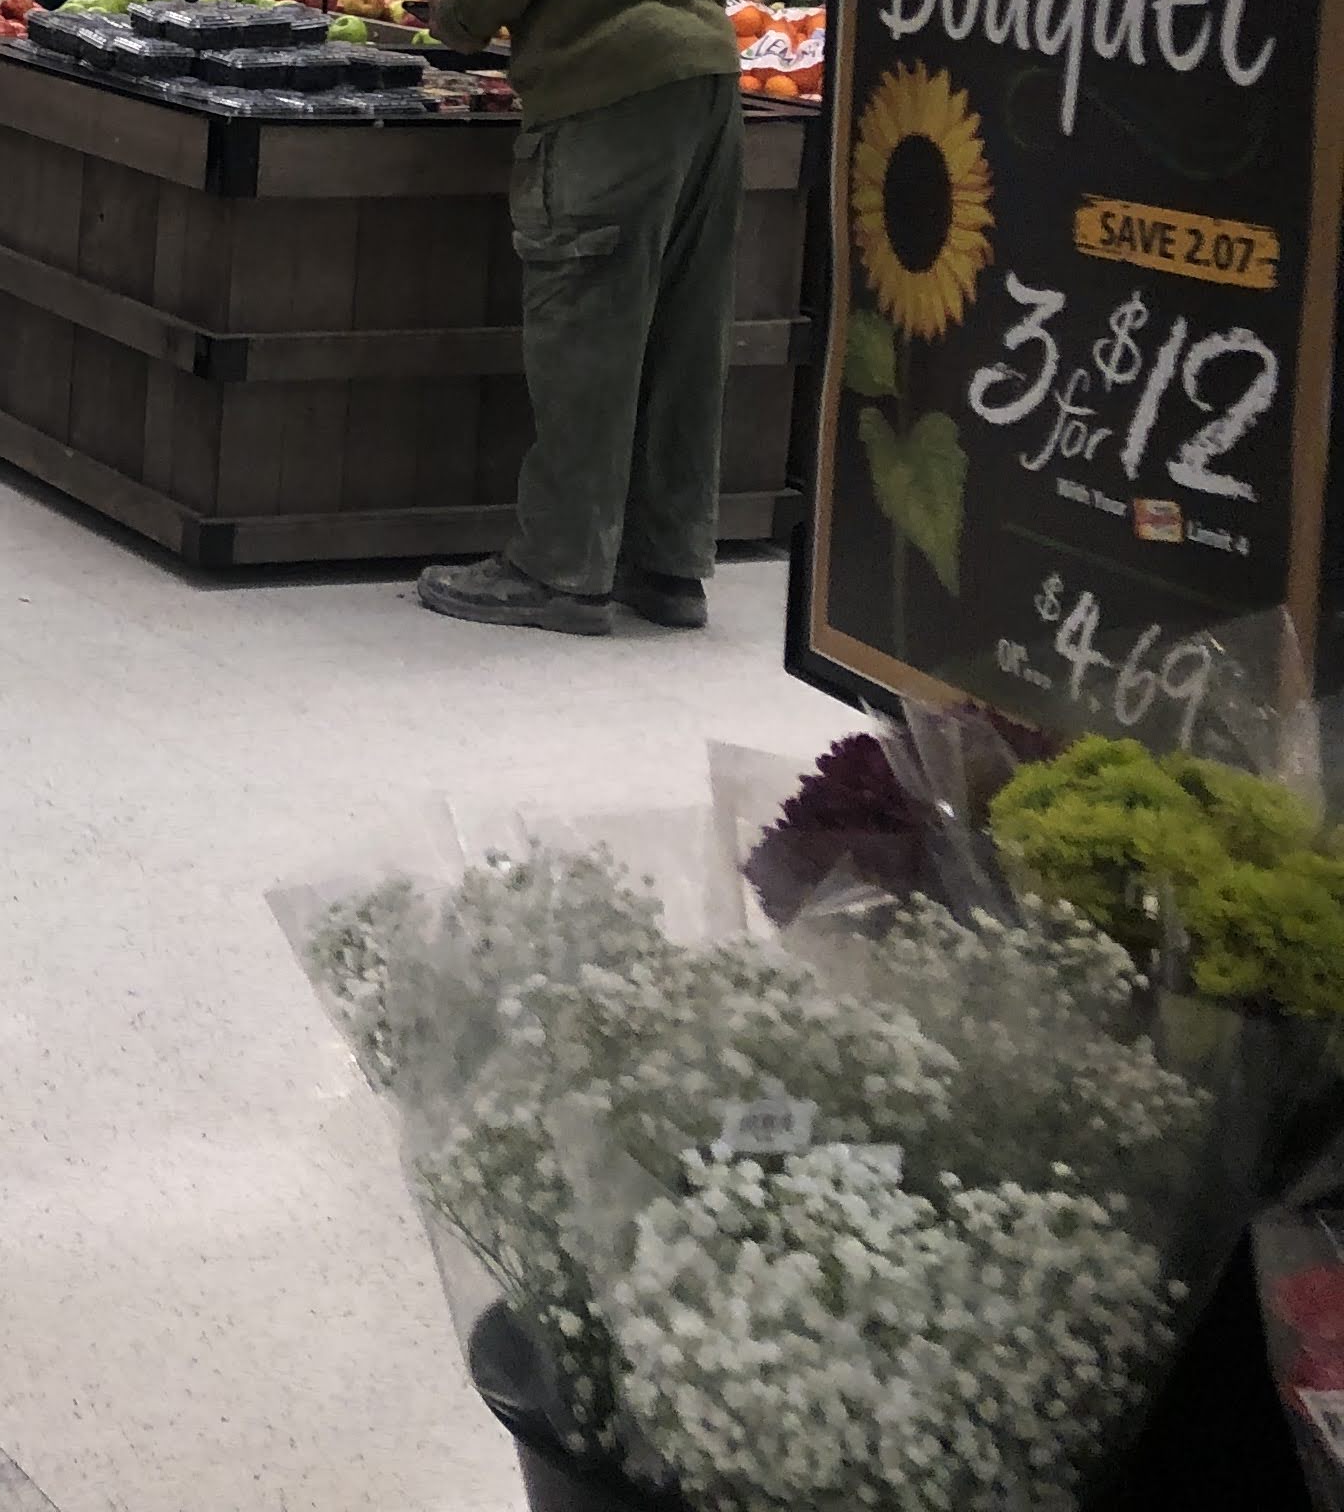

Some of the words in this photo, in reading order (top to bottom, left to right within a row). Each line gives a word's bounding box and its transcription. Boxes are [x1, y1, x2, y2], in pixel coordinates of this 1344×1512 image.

[1099, 211, 1178, 260] SAVE
[1184, 228, 1255, 274] 2.07
[967, 271, 1066, 425] 3
[1019, 368, 1112, 472] for
[1093, 291, 1279, 503] $12
